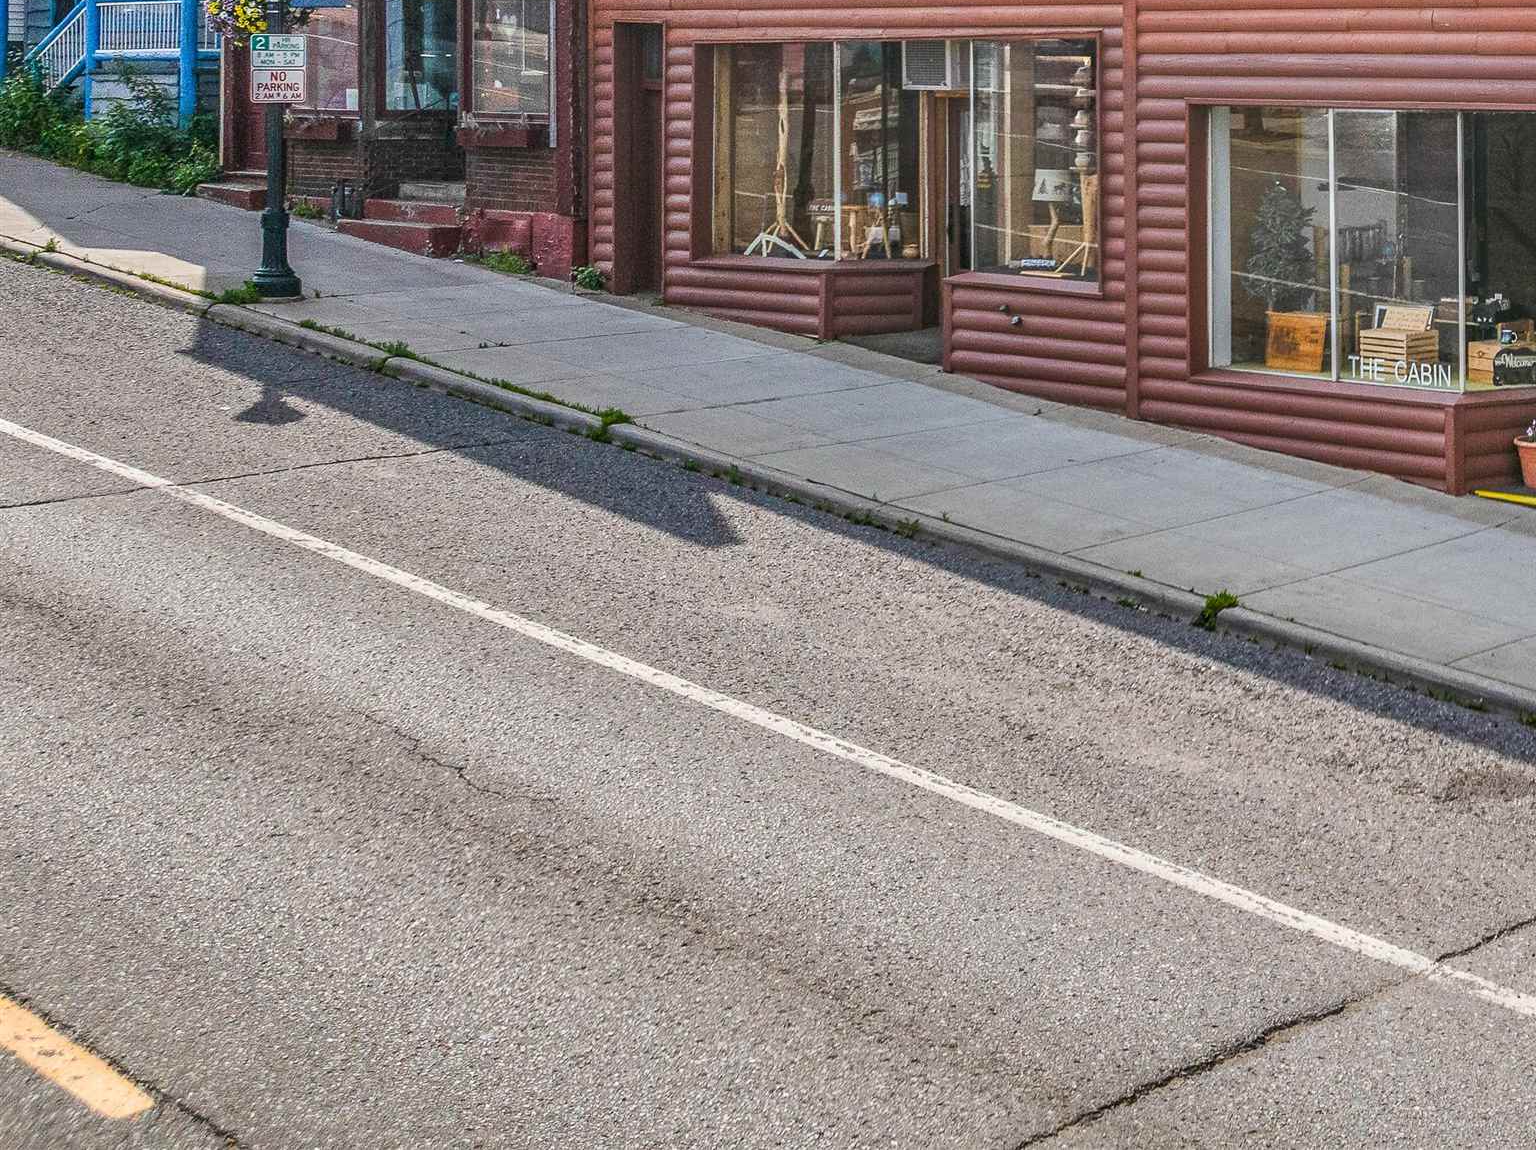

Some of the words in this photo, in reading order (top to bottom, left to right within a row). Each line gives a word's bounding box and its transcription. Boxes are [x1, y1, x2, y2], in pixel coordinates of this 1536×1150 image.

[256, 37, 266, 49] 2
[270, 71, 287, 81] NO
[257, 82, 300, 92] PARKING
[1501, 352, 1536, 369] Welcome
[1348, 354, 1385, 381] THE
[1395, 360, 1452, 387] CABIN
